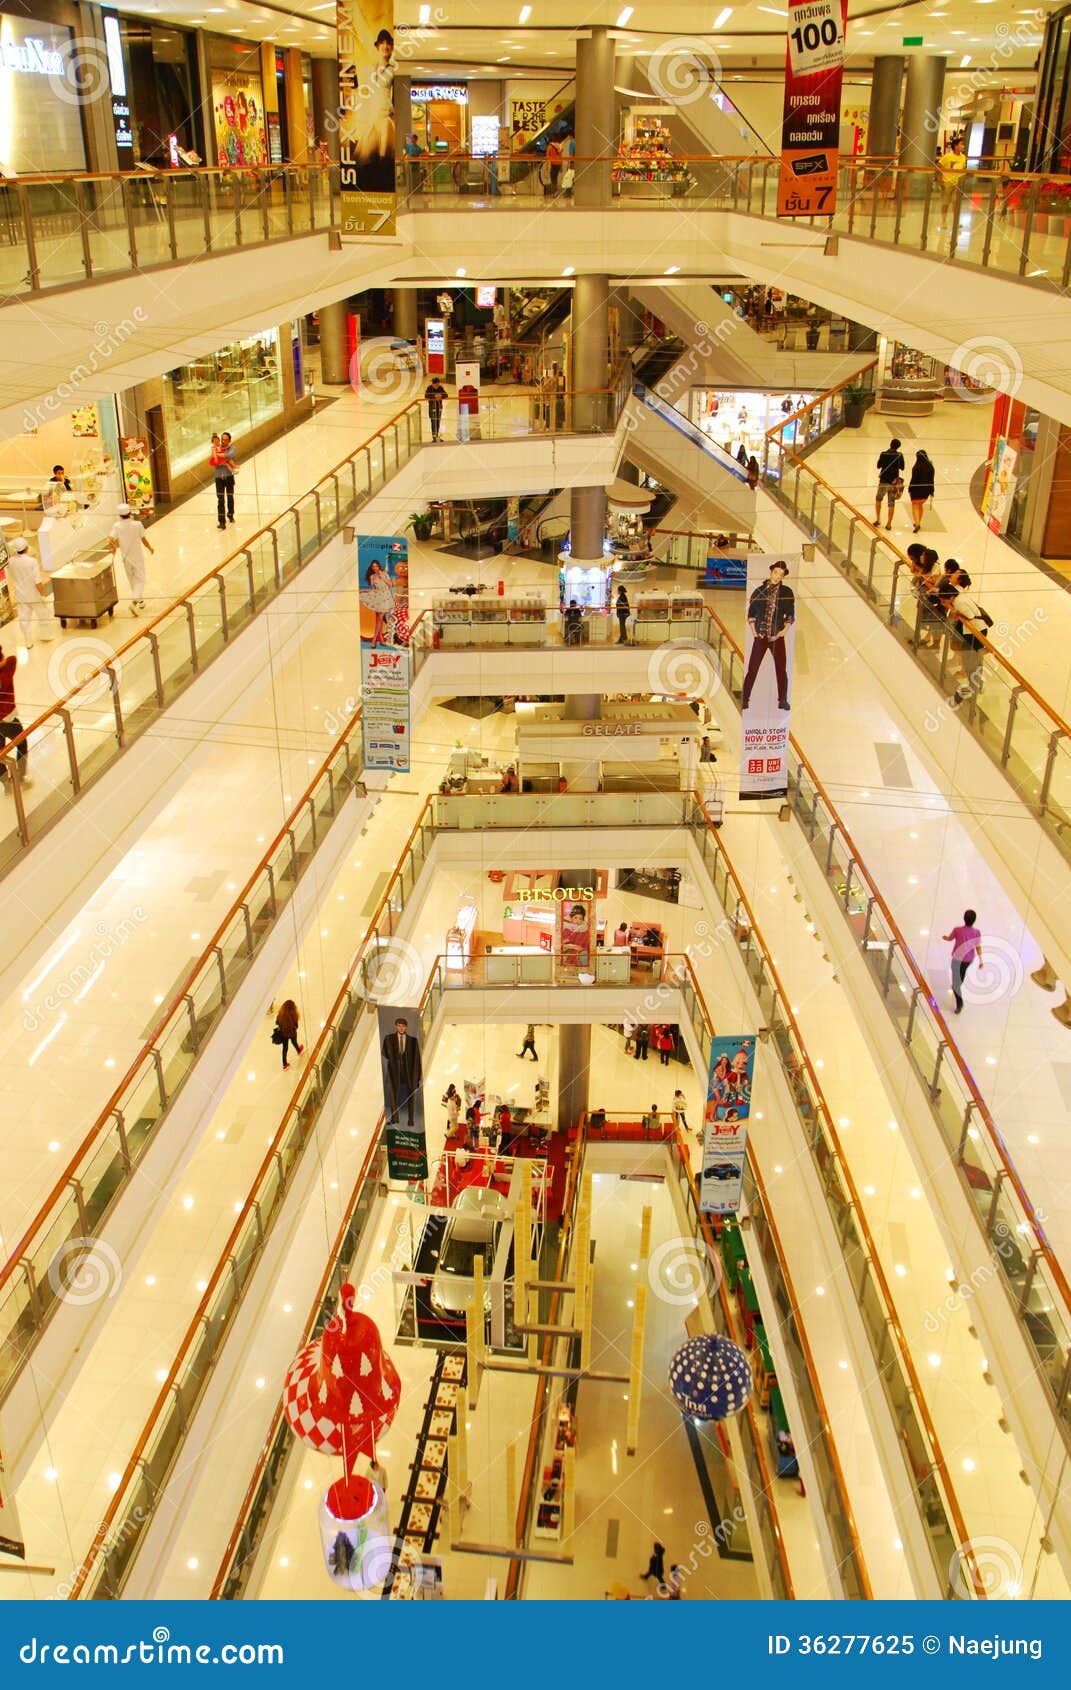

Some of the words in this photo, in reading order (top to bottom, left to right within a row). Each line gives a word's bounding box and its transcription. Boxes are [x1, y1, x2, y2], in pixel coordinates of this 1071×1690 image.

[337, 0, 356, 113] CINEM
[513, 101, 545, 112] TASTE
[339, 123, 357, 185] SFX
[815, 186, 833, 210] 7
[367, 209, 393, 232] 7
[582, 723, 642, 736] GELATE
[517, 887, 594, 902] BISOUS
